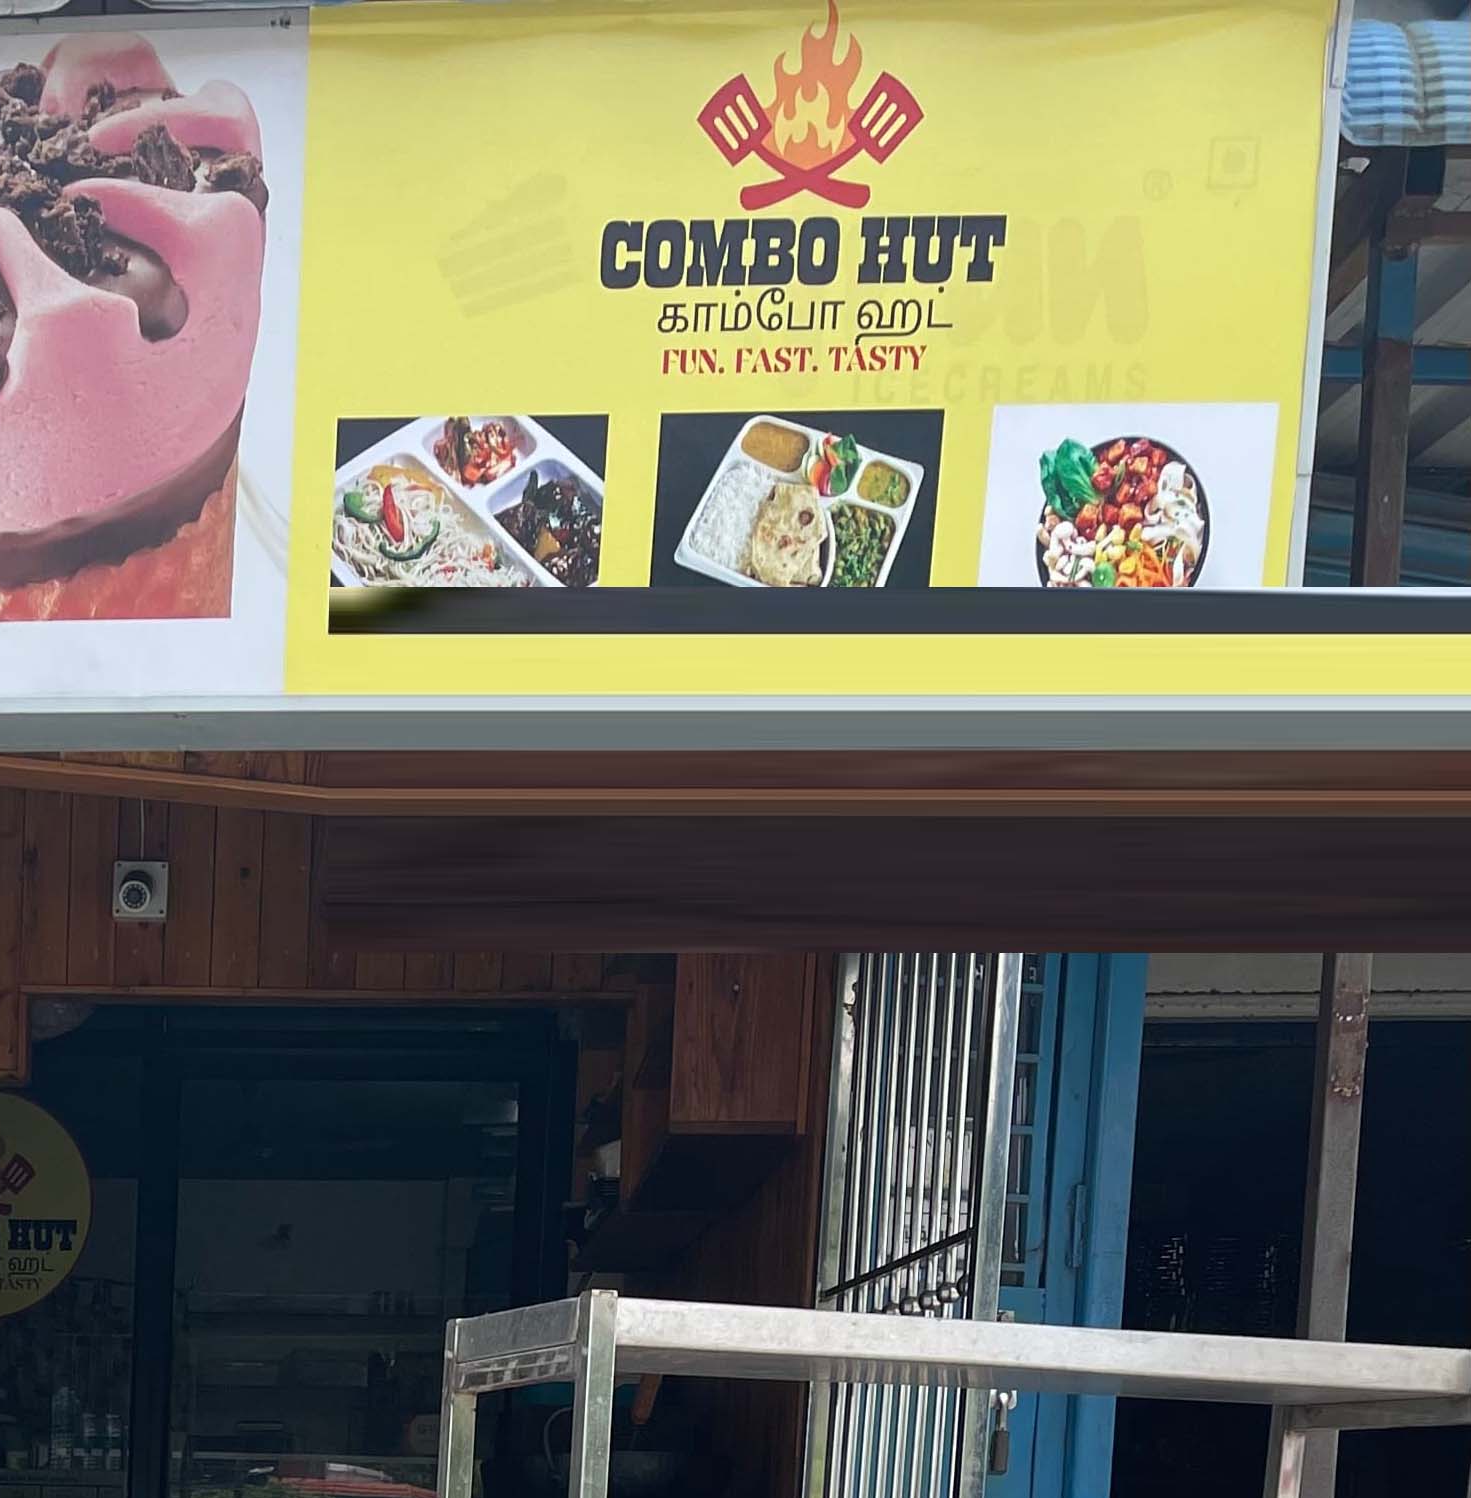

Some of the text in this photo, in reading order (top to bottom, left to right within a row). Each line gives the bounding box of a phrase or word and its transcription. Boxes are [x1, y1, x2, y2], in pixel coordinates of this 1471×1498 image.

[599, 214, 1008, 290] COMBO HUT
[656, 285, 954, 346] காம்போ ஹட்
[660, 344, 928, 375] FUN. FAST. TASTY
[7, 1218, 78, 1251] HUT
